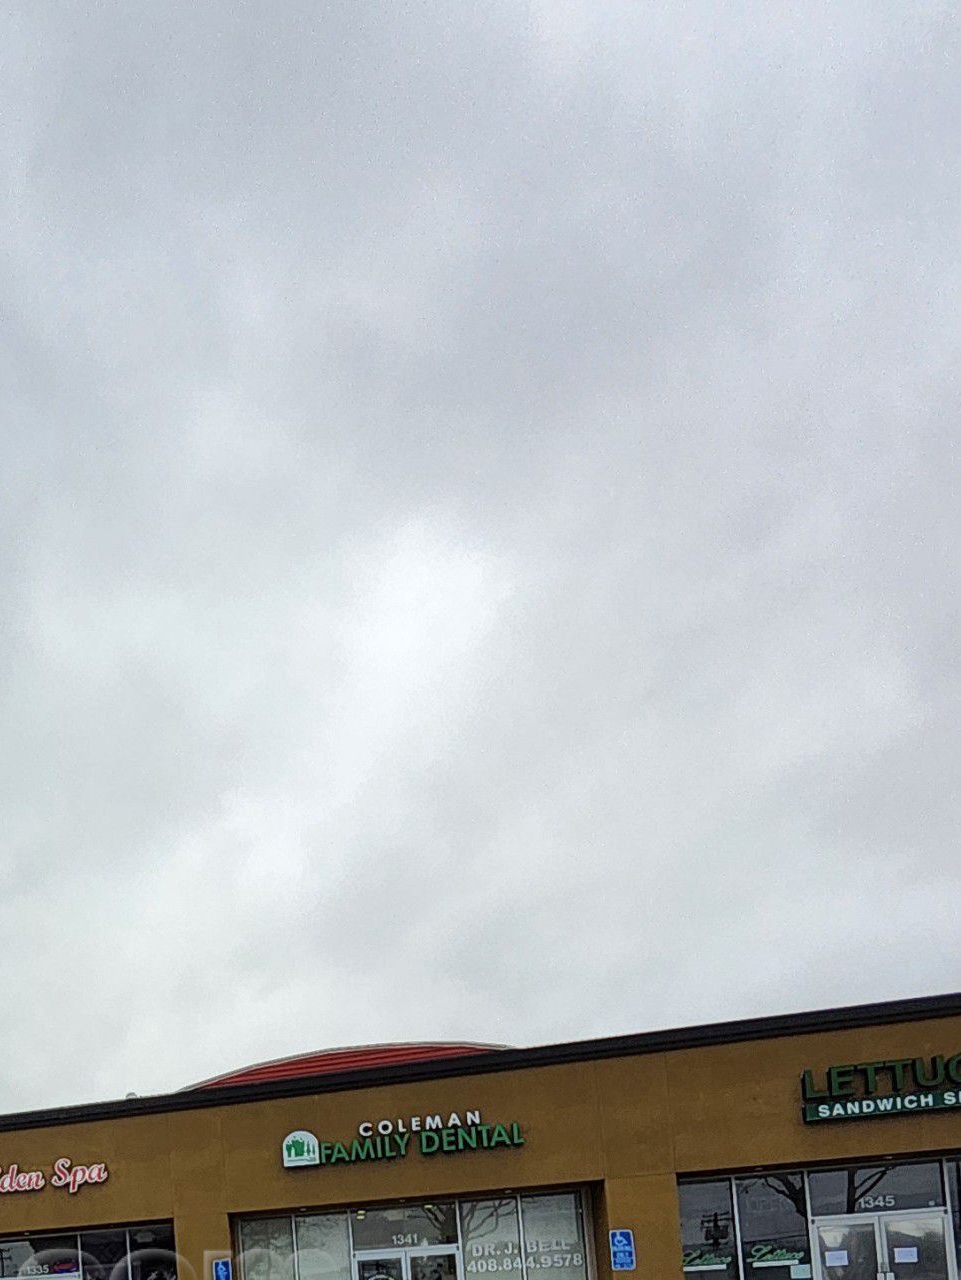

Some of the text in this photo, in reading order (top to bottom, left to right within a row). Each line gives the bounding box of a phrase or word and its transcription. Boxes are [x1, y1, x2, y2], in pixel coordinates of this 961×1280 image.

[818, 1089, 961, 1118] SANDWICH S
[358, 1110, 481, 1137] COLEMAN
[320, 1122, 526, 1164] FAMILY DENTAL
[51, 1157, 108, 1193] Spa
[858, 1195, 895, 1209] 1345
[391, 1233, 418, 1245] 1341
[471, 1239, 571, 1257] DR. J. BELL
[27, 1264, 50, 1275] 1335
[466, 1253, 583, 1273] 408.844.9578
